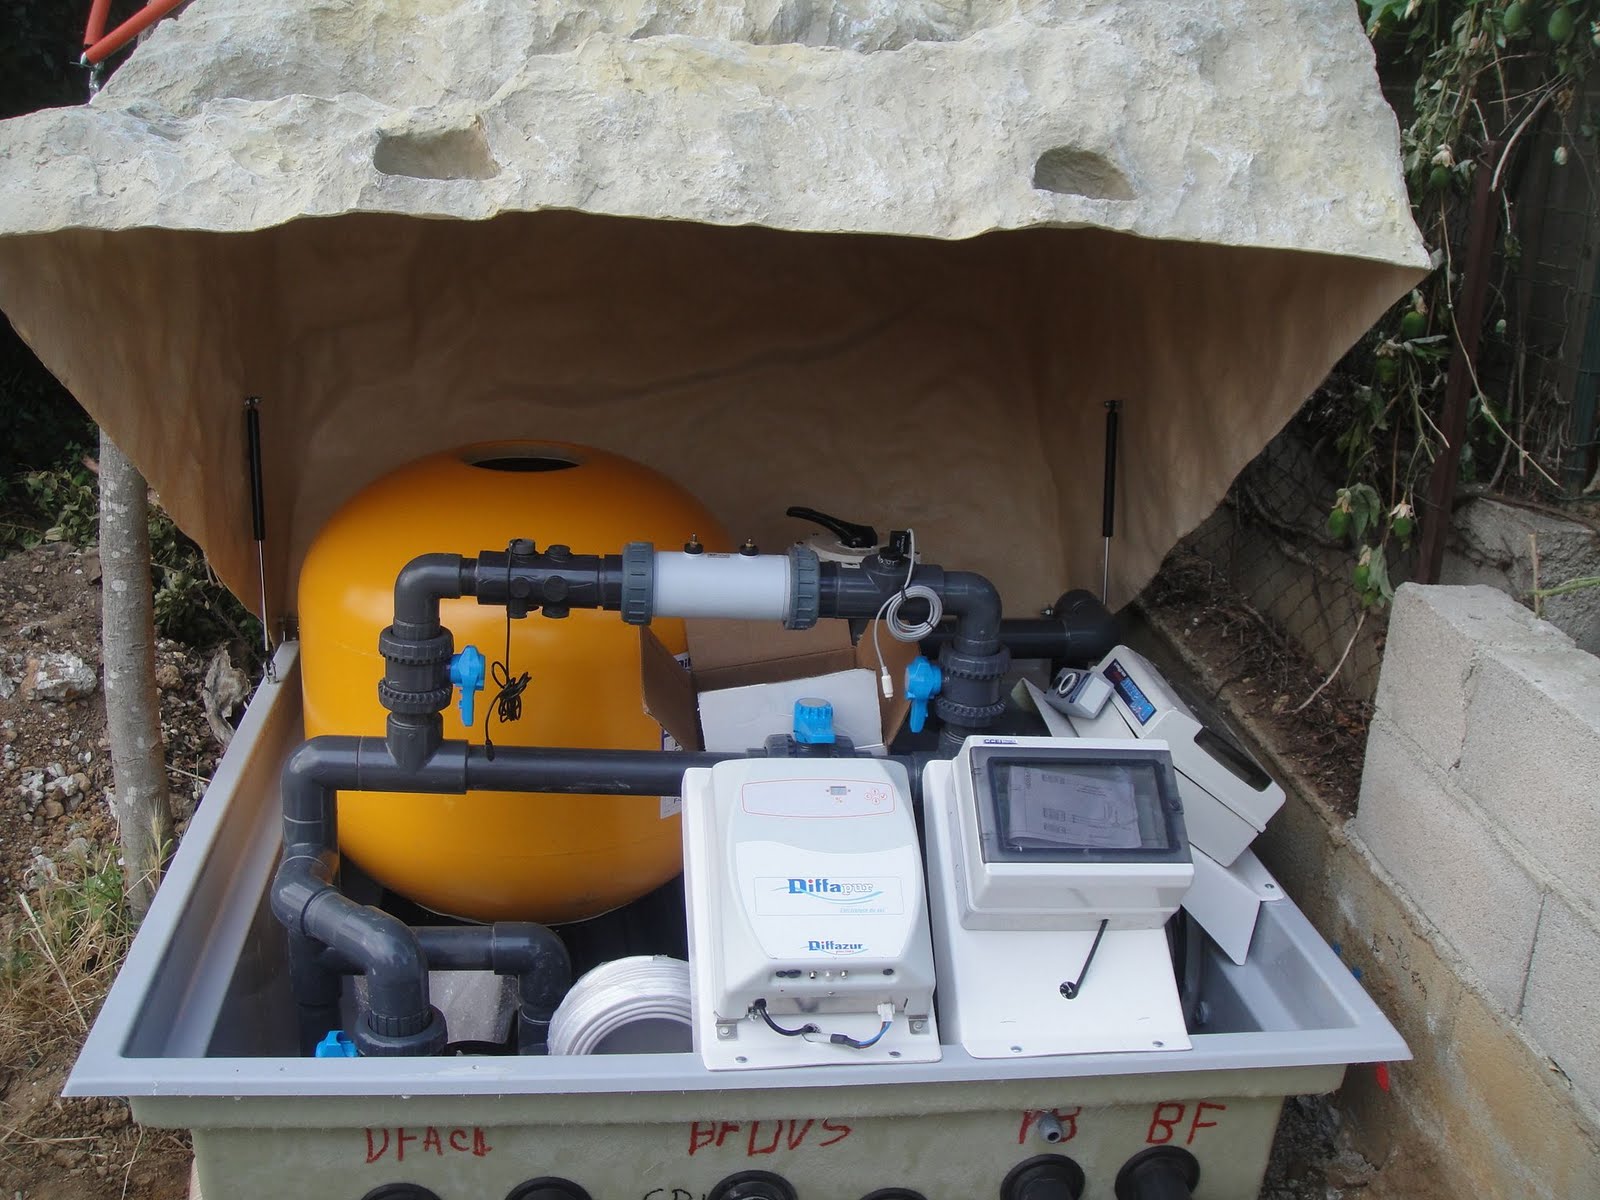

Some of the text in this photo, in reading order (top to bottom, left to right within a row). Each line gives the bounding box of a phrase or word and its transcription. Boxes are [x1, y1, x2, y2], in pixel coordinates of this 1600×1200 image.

[787, 878, 873, 895] Diffapur
[808, 940, 863, 951] Diffazur
[1146, 1102, 1226, 1145] BF
